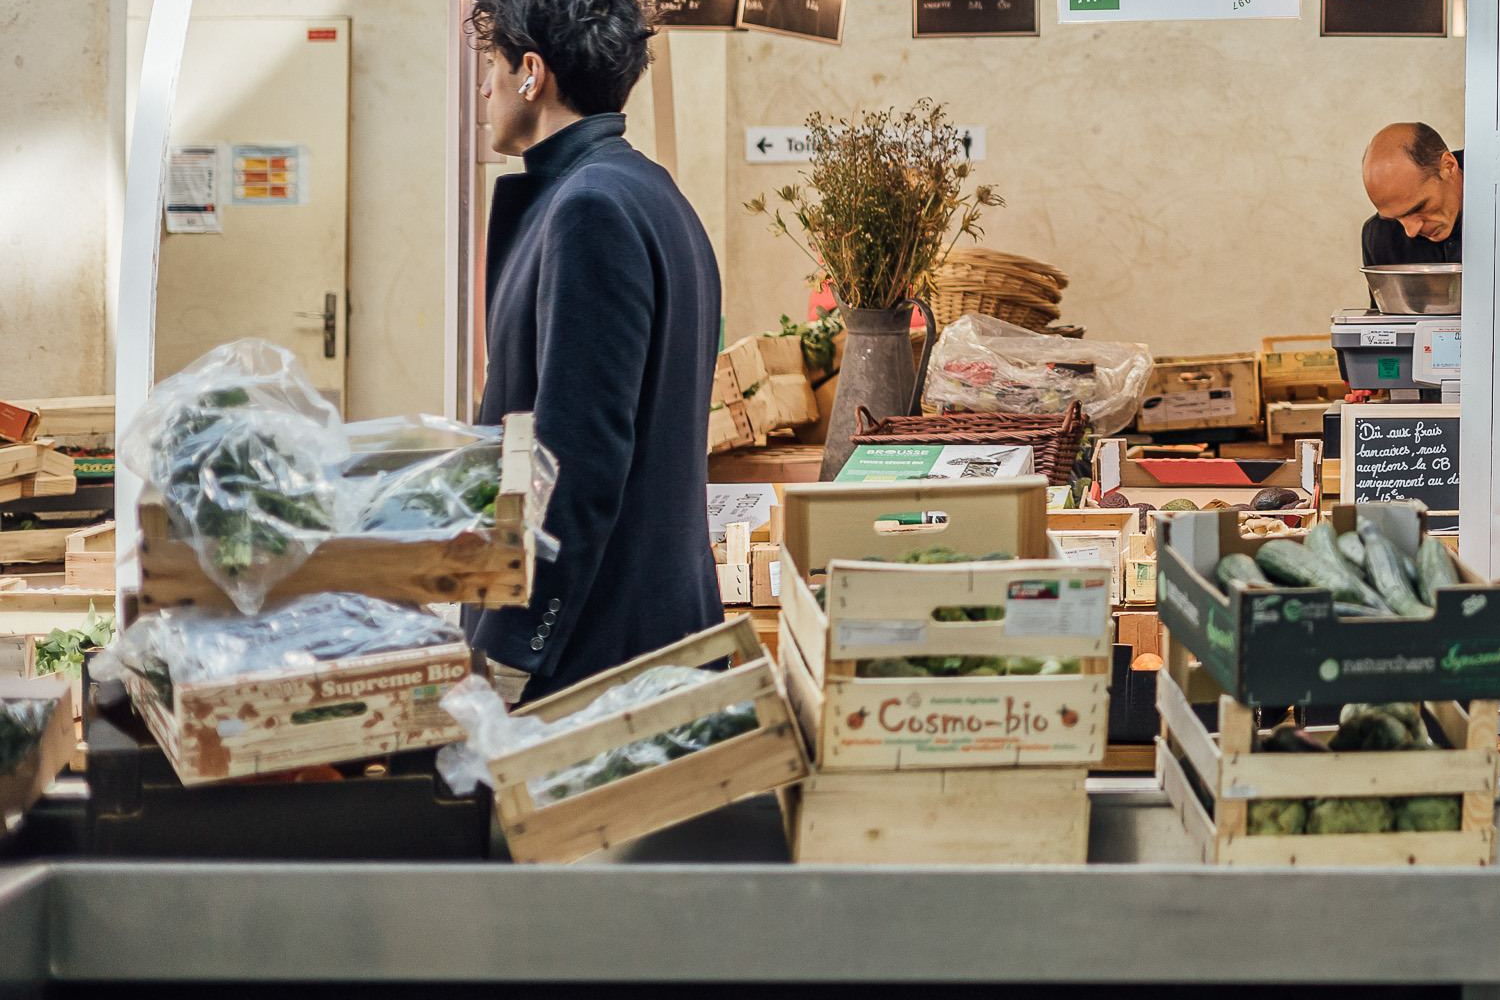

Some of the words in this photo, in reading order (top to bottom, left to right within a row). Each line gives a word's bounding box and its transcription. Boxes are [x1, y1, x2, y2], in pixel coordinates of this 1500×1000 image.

[1386, 428, 1411, 438] aux
[1414, 421, 1443, 443] frais
[1356, 444, 1415, 457] bancaires,
[1416, 444, 1447, 454] nous
[1357, 461, 1408, 478] acceptons
[1410, 458, 1427, 470] la
[1432, 457, 1451, 470] CB
[1356, 474, 1424, 496] uniquement
[1428, 477, 1444, 486] au
[1357, 493, 1369, 504] de
[321, 669, 422, 697] Supreme
[427, 663, 464, 682] Bio
[879, 696, 1048, 735] Cosmo-bio
